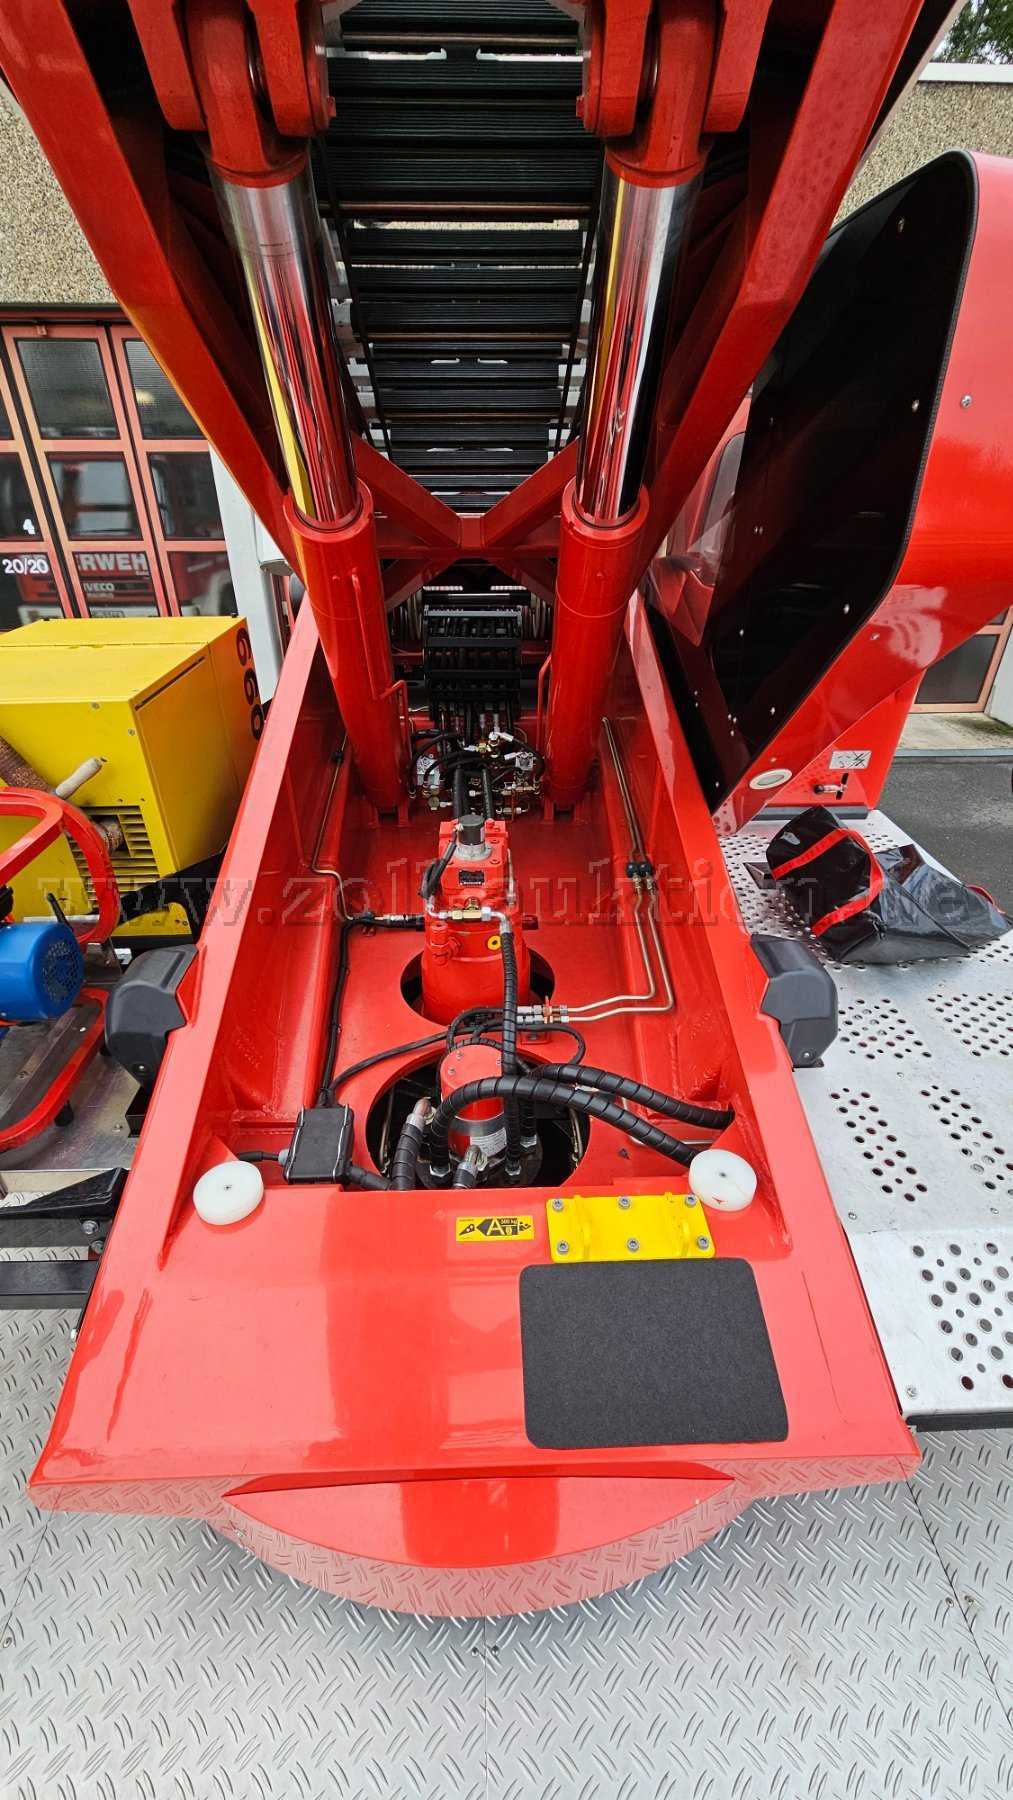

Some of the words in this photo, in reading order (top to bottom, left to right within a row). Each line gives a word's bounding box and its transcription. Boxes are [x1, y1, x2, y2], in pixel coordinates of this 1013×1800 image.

[23, 519, 35, 534] 4
[2, 557, 49, 575] 20/20
[83, 583, 115, 591] IVECO
